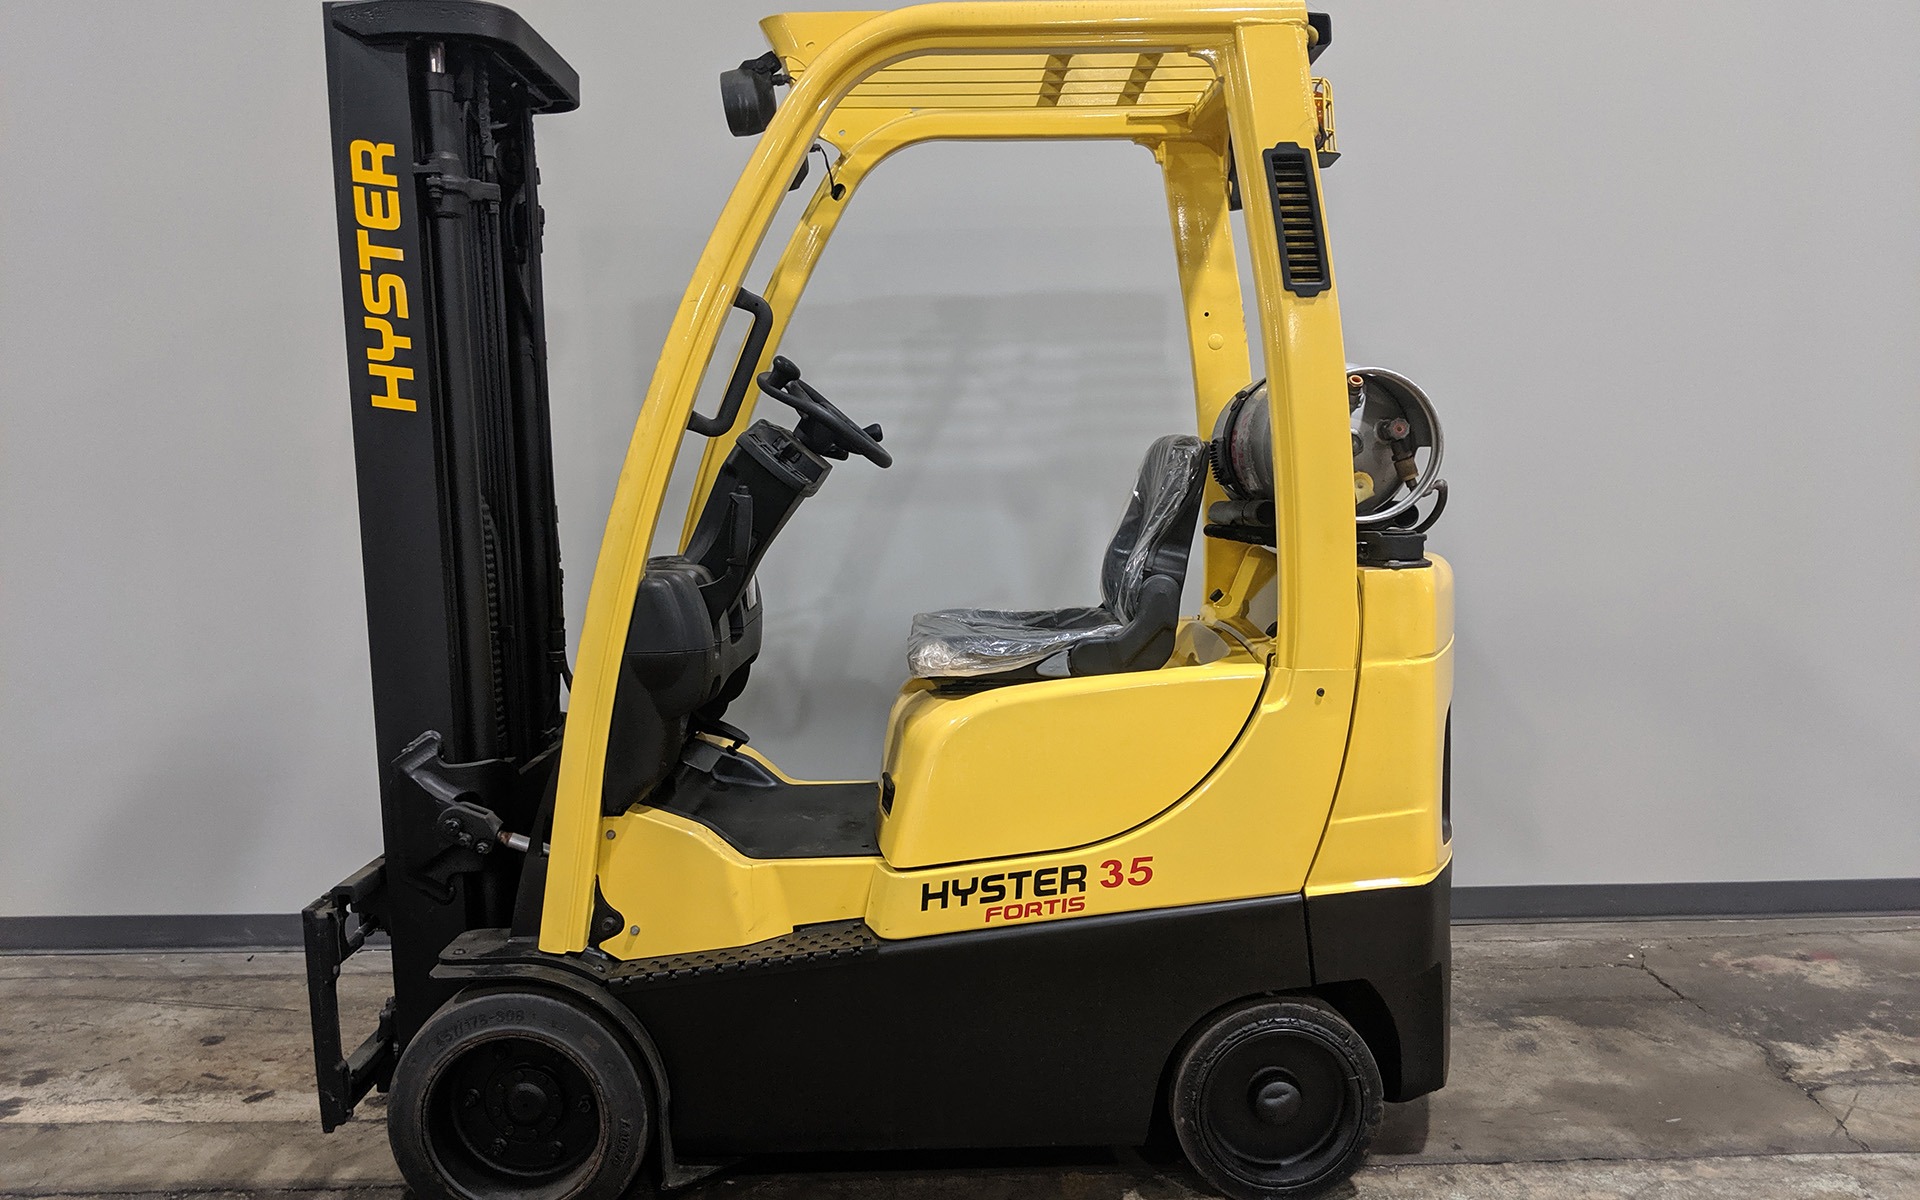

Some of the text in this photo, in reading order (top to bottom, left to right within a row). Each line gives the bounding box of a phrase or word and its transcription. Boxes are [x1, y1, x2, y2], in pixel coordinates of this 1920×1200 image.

[350, 139, 417, 412] HYSTER
[920, 856, 1154, 912] HYSTER 35
[985, 896, 1086, 923] FORTIS
